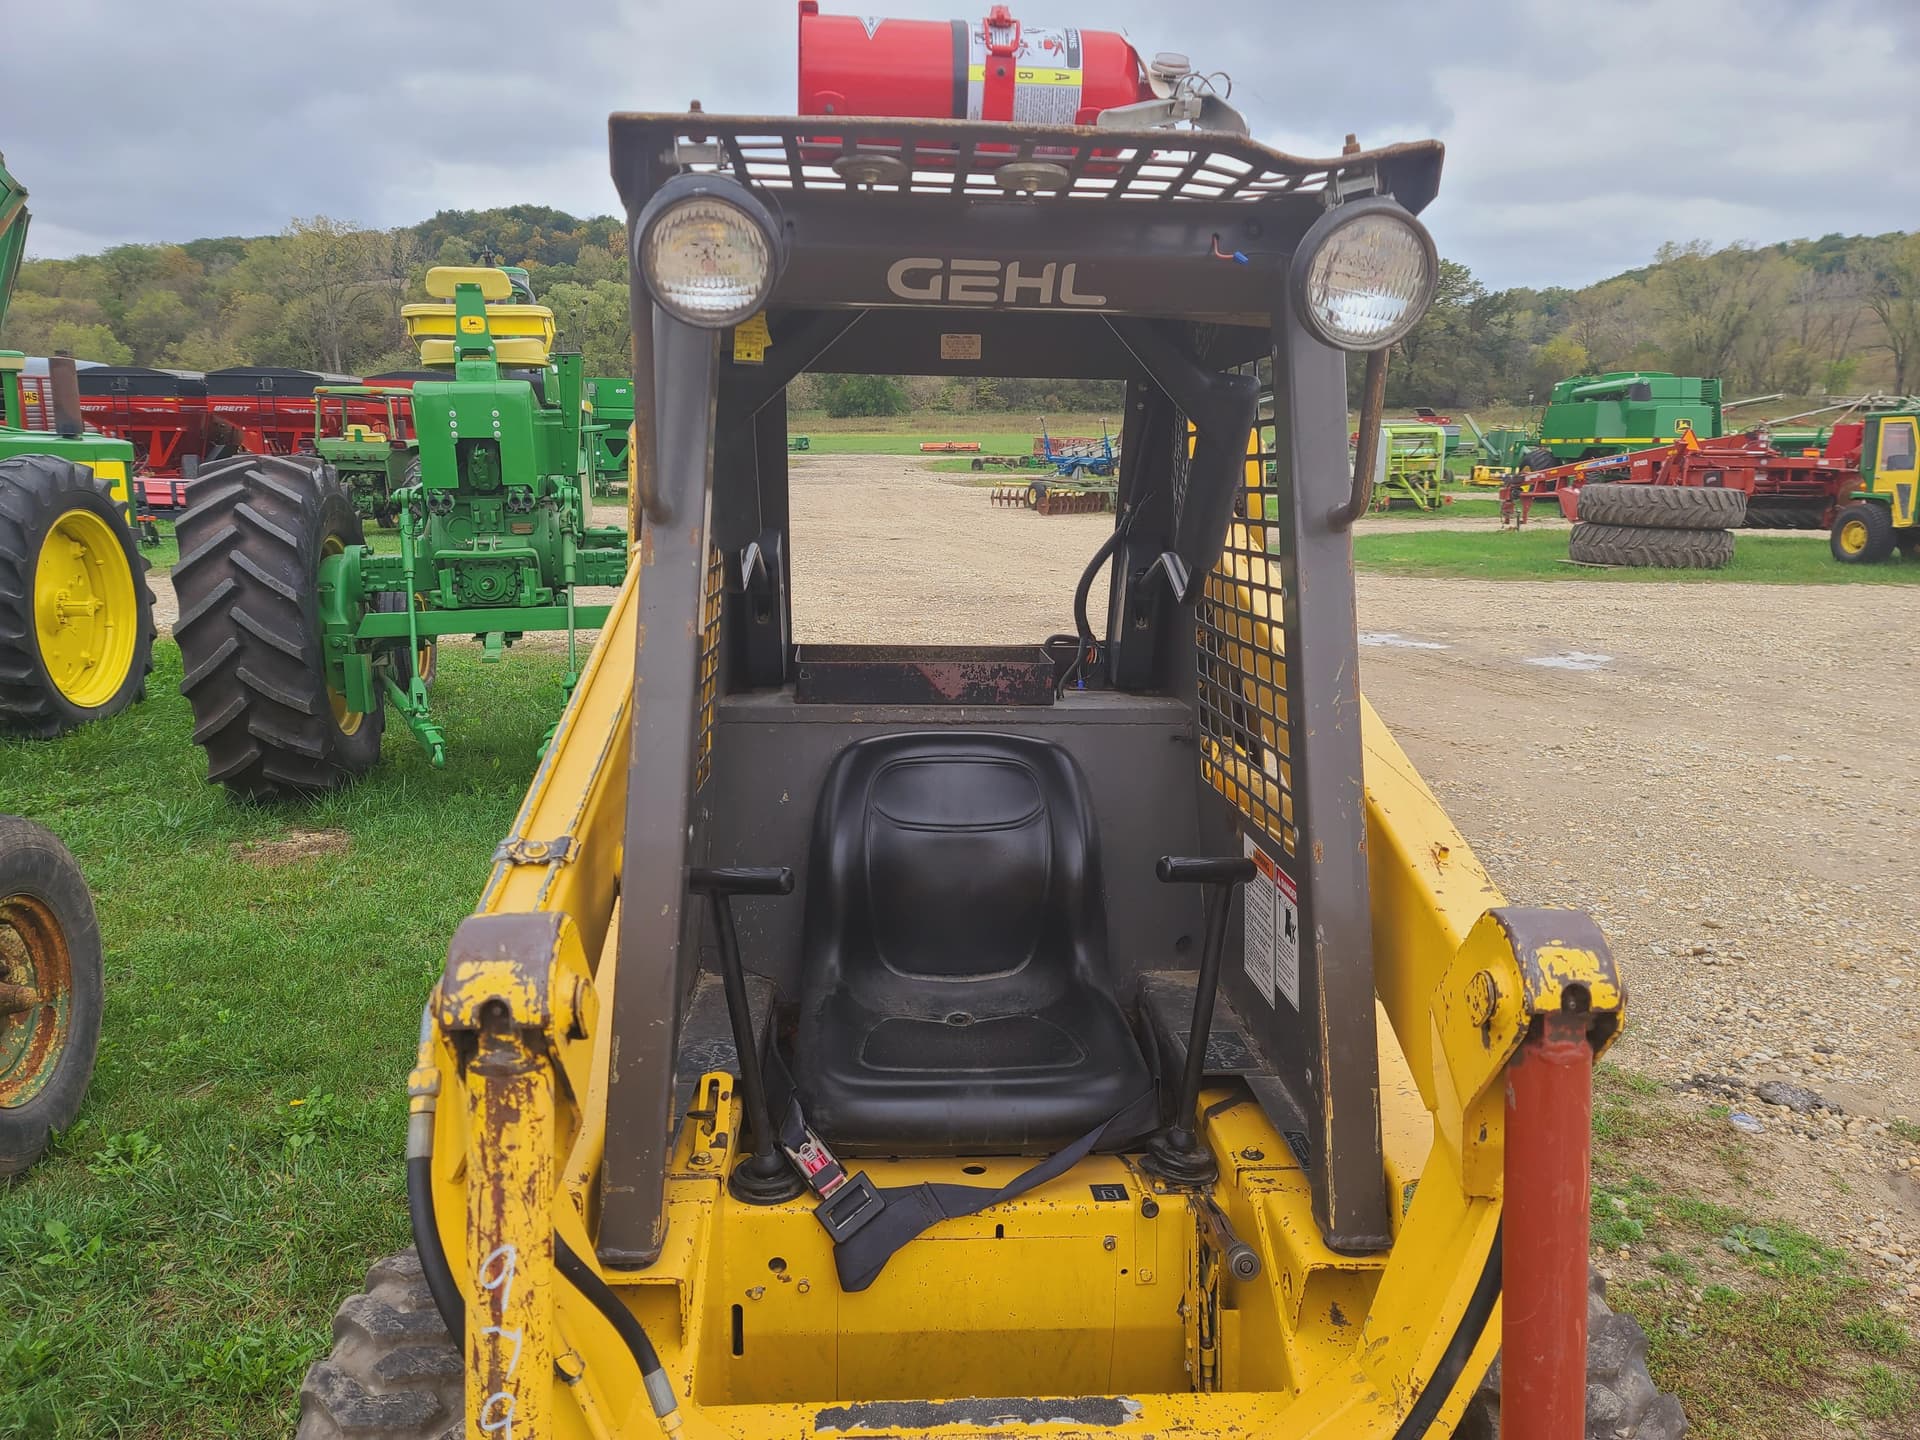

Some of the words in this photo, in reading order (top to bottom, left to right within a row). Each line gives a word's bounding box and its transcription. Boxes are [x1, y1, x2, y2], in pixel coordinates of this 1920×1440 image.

[1019, 71, 1034, 79] B
[1055, 72, 1070, 81] A
[887, 257, 1107, 305] GEHL
